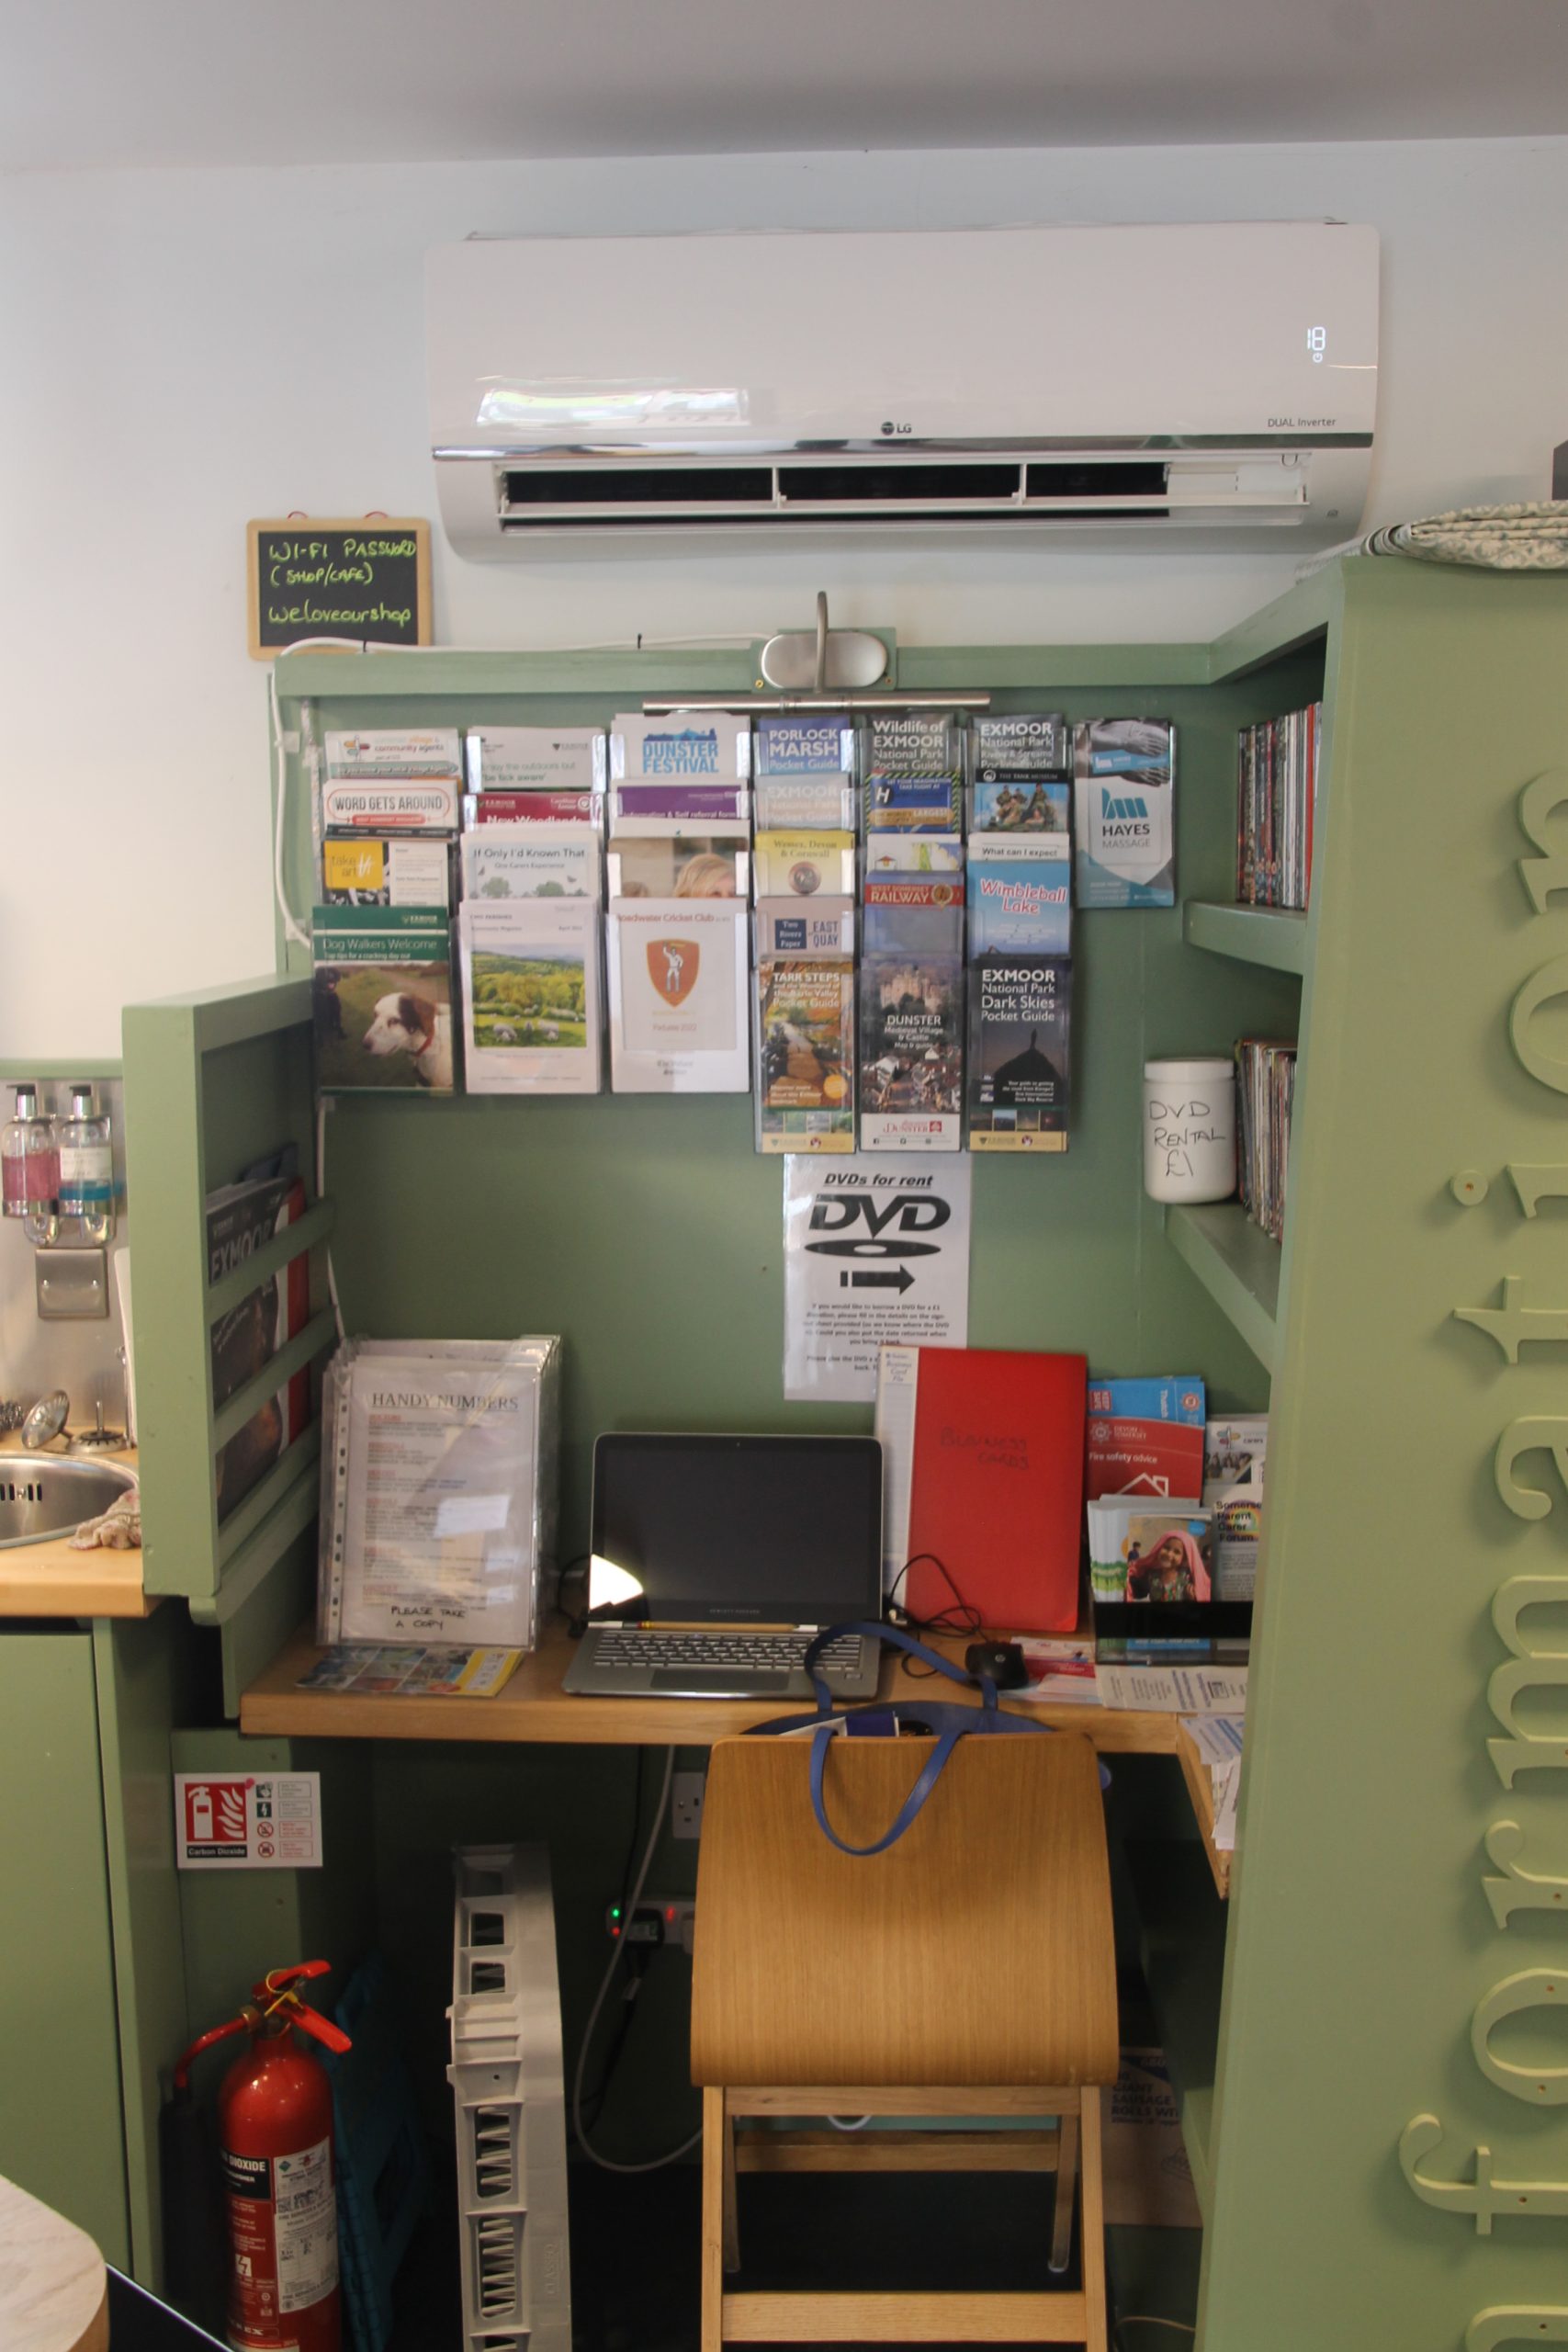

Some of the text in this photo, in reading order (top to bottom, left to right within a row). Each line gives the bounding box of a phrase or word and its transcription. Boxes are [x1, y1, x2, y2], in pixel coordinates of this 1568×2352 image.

[1307, 326, 1326, 351] 18
[897, 423, 912, 434] LG
[1268, 418, 1337, 427] DUAL Inverter
[874, 720, 945, 733] Wildlife of
[980, 722, 1053, 736] EXMOOR
[769, 729, 838, 741] PORLOCK
[874, 736, 943, 748] EXMOOR
[981, 737, 1053, 747] National Park
[643, 741, 718, 758] DUNSTER
[770, 742, 839, 758] MARSH
[874, 749, 943, 759] National Park
[643, 758, 720, 773] FESTIVAL
[771, 758, 839, 770] Pocket Guide
[874, 760, 943, 771] Pocket Guide
[335, 796, 443, 810] WORD GETS AROUND
[1102, 824, 1150, 836] HAYES
[808, 840, 837, 849] Devon
[1102, 839, 1151, 849] MASSAGE
[473, 848, 481, 857] If
[484, 849, 508, 859] Only
[526, 849, 560, 857] Known
[562, 848, 585, 857] That
[982, 847, 1005, 856] What
[1029, 848, 1057, 857] expect
[342, 866, 356, 877] art
[980, 878, 1067, 904] Wimbleball
[871, 892, 930, 903] RAILWAY
[1002, 899, 1040, 915] Lake
[813, 921, 839, 933] EAST
[779, 930, 803, 939] Rivers
[323, 938, 437, 950] Dog Walkers Welcome
[780, 939, 801, 949] Paper
[813, 935, 839, 948] QUAY
[773, 972, 840, 981] TARR STEPS
[982, 969, 1055, 982] EXMOOR
[813, 989, 839, 999] Valley
[982, 983, 1055, 994] National Park
[773, 998, 839, 1008] Pocket Guide
[981, 995, 1055, 1009] Dark Skies
[887, 1014, 942, 1026] DUNSTER
[981, 1011, 1055, 1022] Pocket Guide
[918, 1026, 944, 1035] Village
[1148, 1101, 1211, 1120] DVD
[1154, 1126, 1226, 1152] RENTAL
[824, 1173, 934, 1187] DVDs for rent
[808, 1193, 952, 1239] DVD
[372, 1392, 434, 1409] HANDY
[1089, 1453, 1157, 1464] Fire safety advice
[1217, 1511, 1251, 1521] Parent
[1218, 1522, 1247, 1531] Carer
[395, 1620, 445, 1632] A COPY
[189, 1848, 246, 1856] Carbon Dioxide
